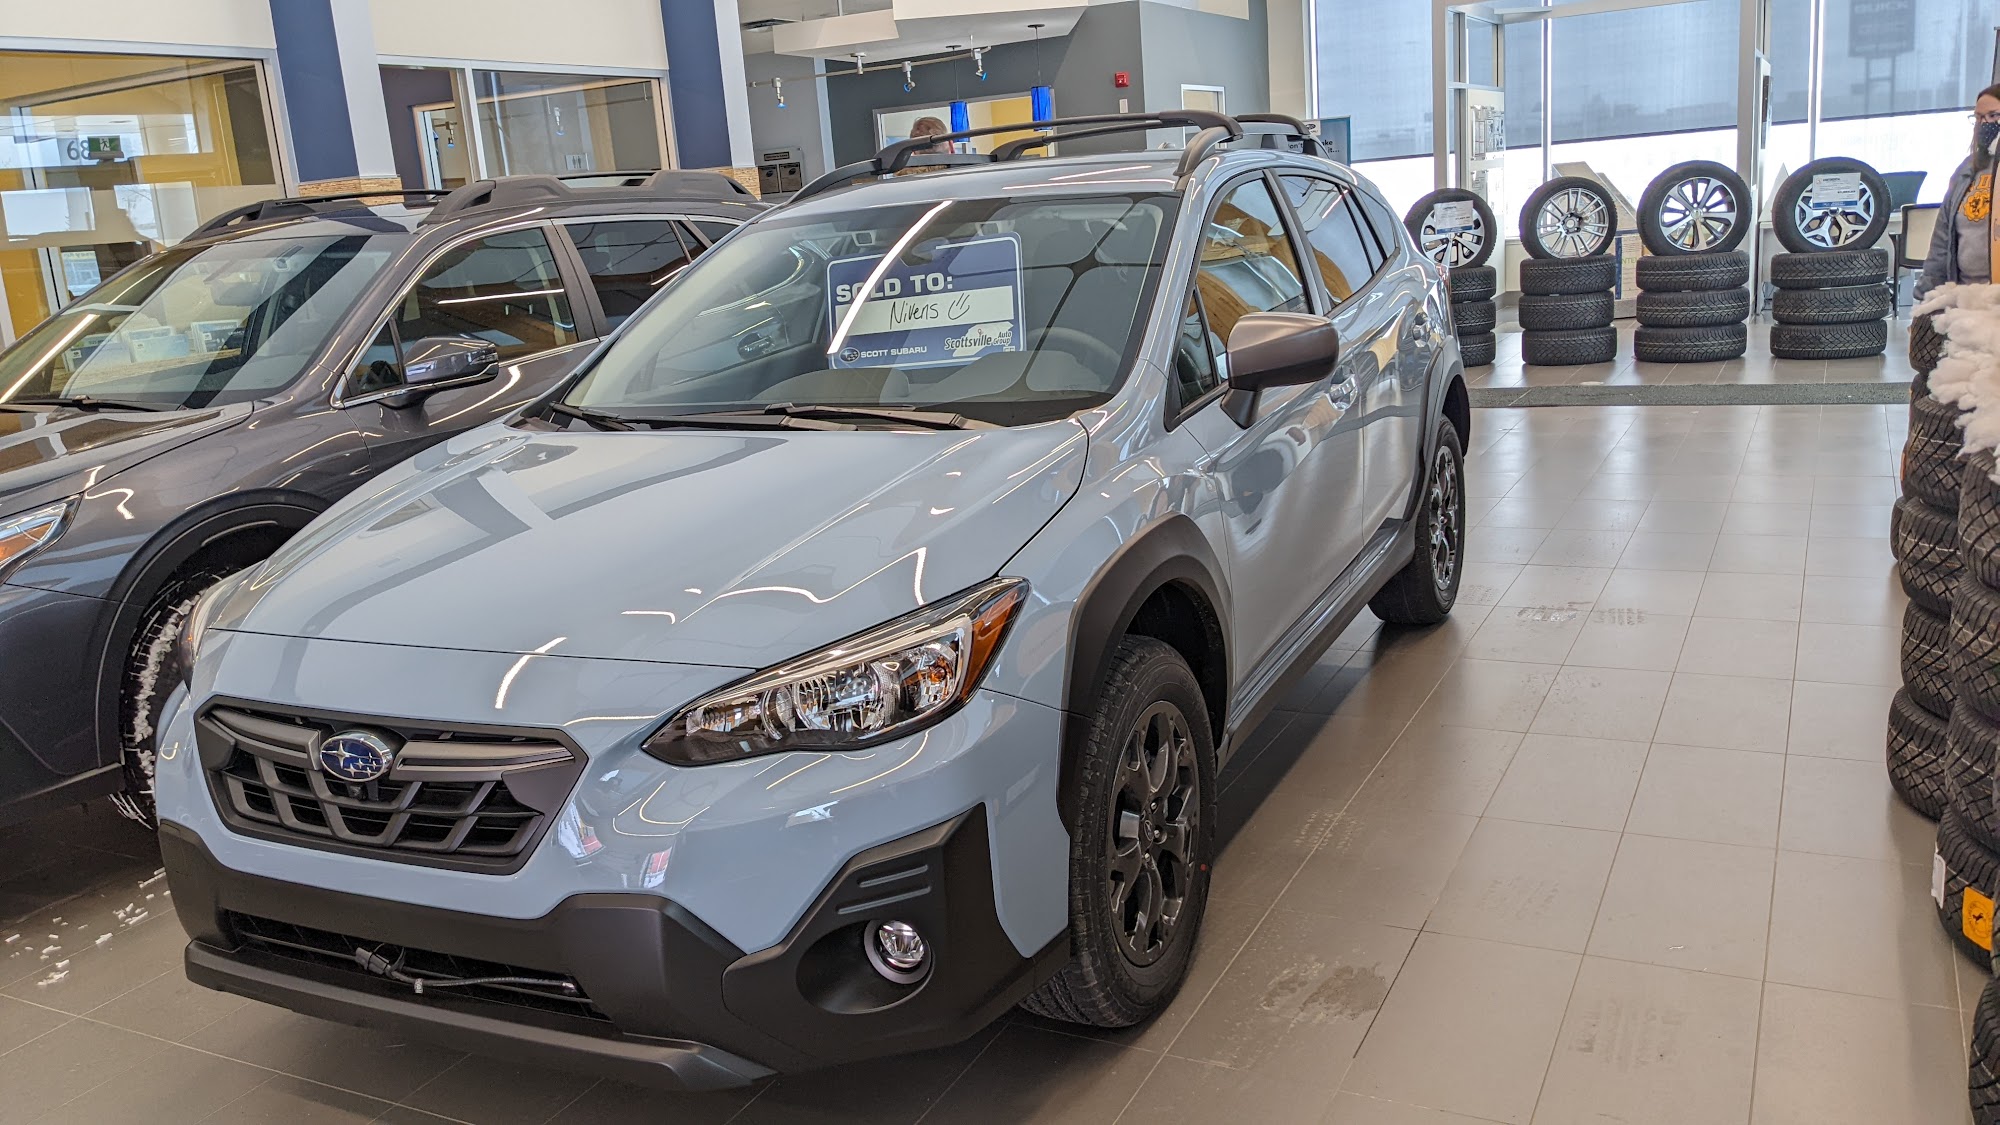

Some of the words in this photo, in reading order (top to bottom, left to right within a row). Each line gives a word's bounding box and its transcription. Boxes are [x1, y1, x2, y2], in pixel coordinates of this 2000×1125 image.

[909, 272, 953, 293] TO:
[997, 331, 1012, 339] Auto
[944, 334, 992, 351] Scottsville
[993, 337, 1011, 346] Group
[860, 349, 889, 358] SCOTT
[890, 346, 928, 356] SUBARU
